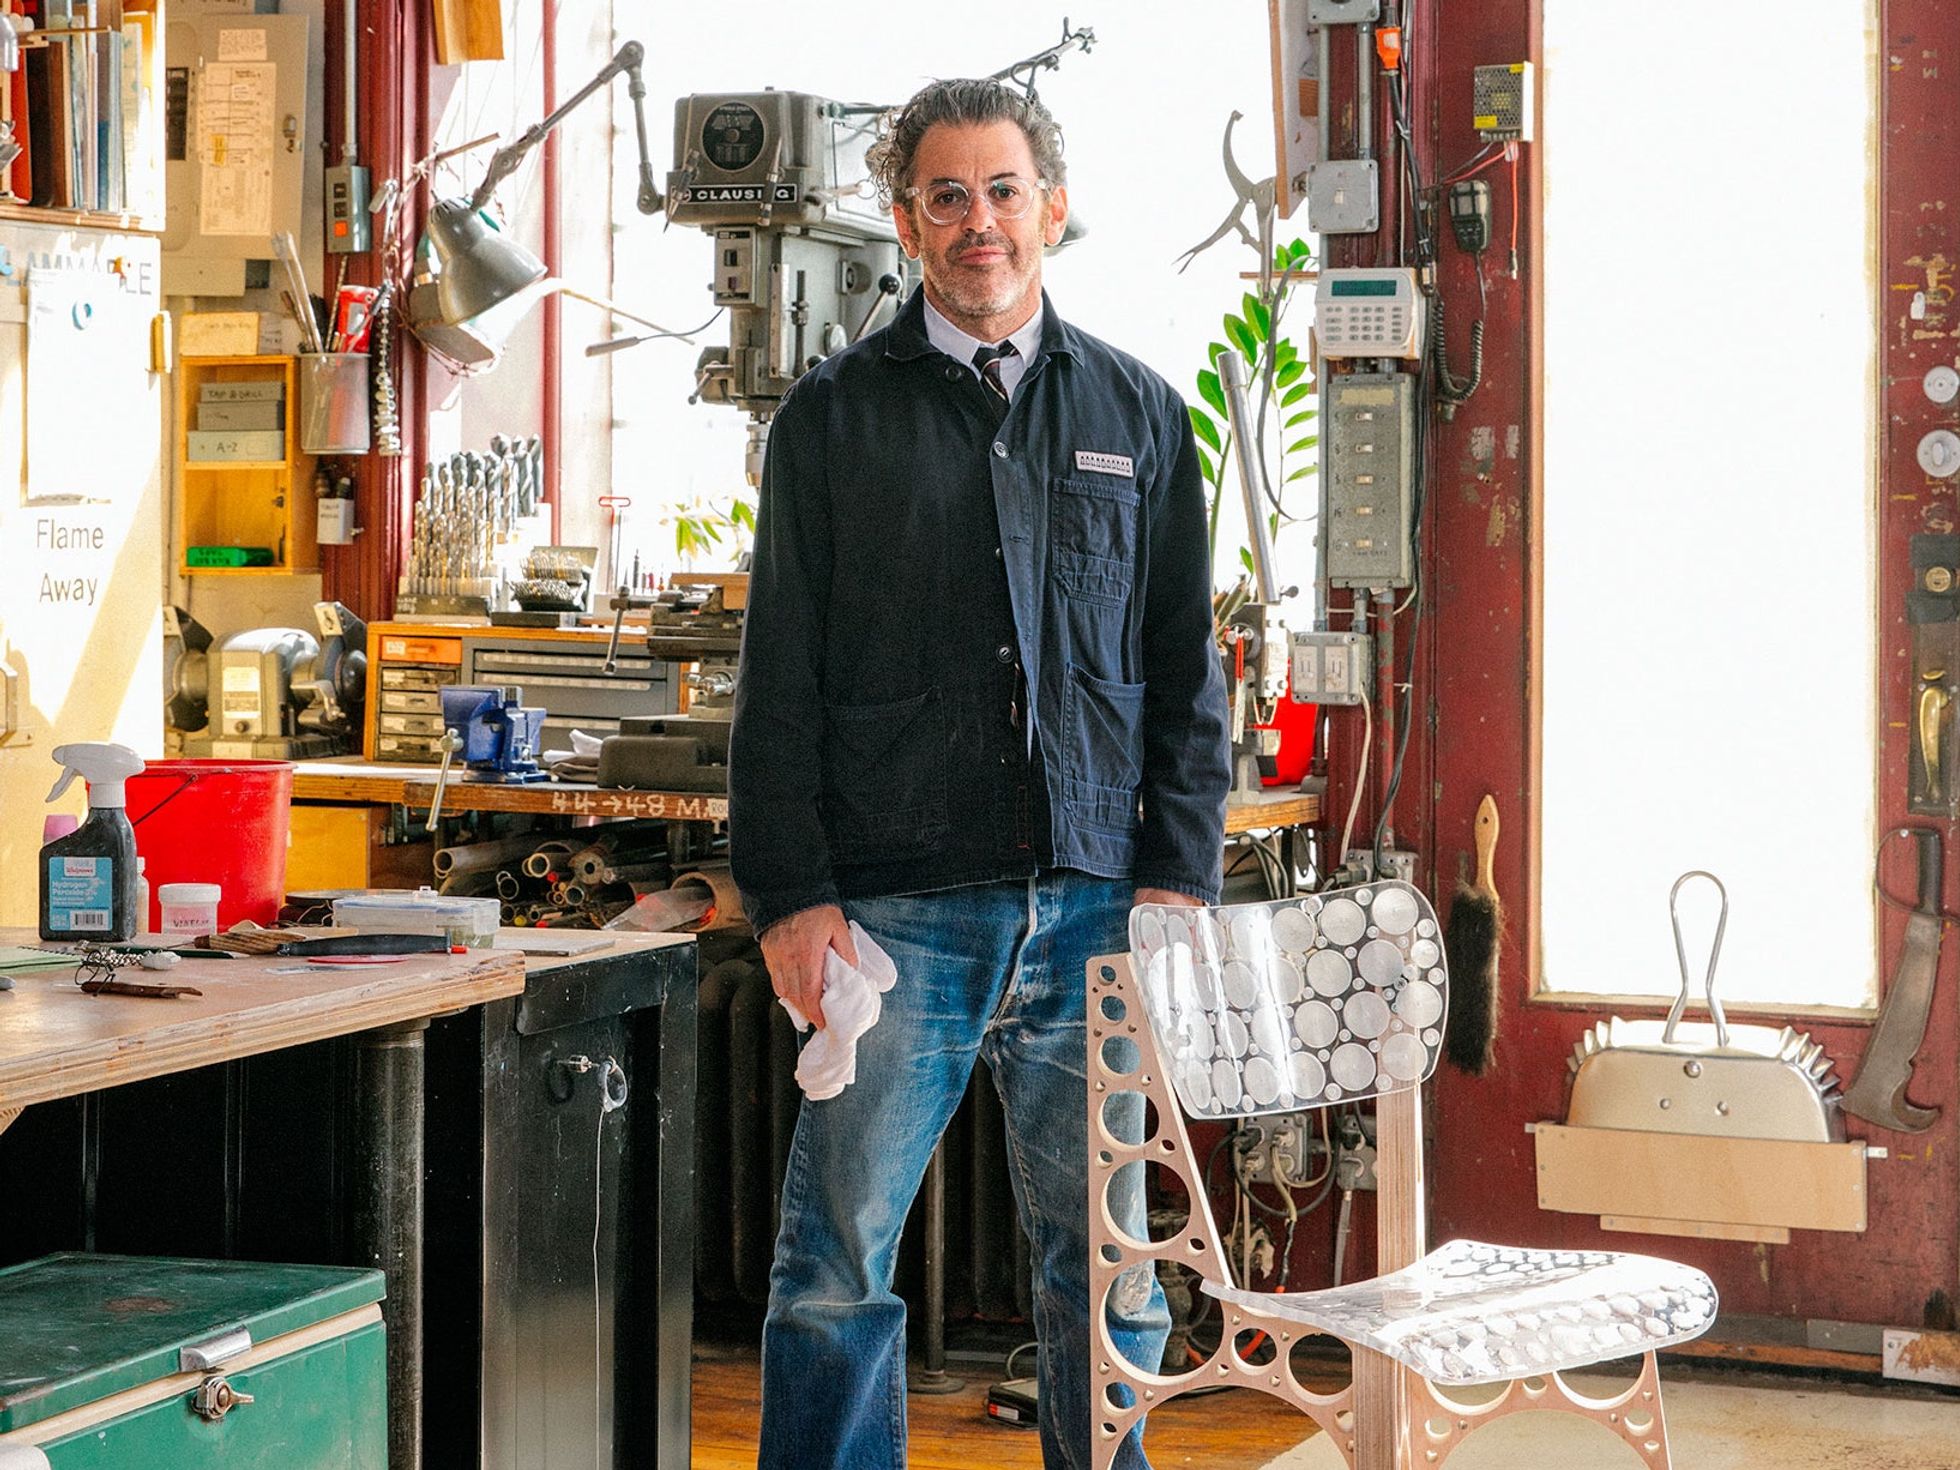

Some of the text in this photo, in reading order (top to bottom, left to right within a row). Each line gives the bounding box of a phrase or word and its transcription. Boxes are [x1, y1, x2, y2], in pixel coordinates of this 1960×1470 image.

[697, 189, 789, 200] CLAUSIG
[36, 518, 104, 549] Flame
[39, 572, 98, 606] Away
